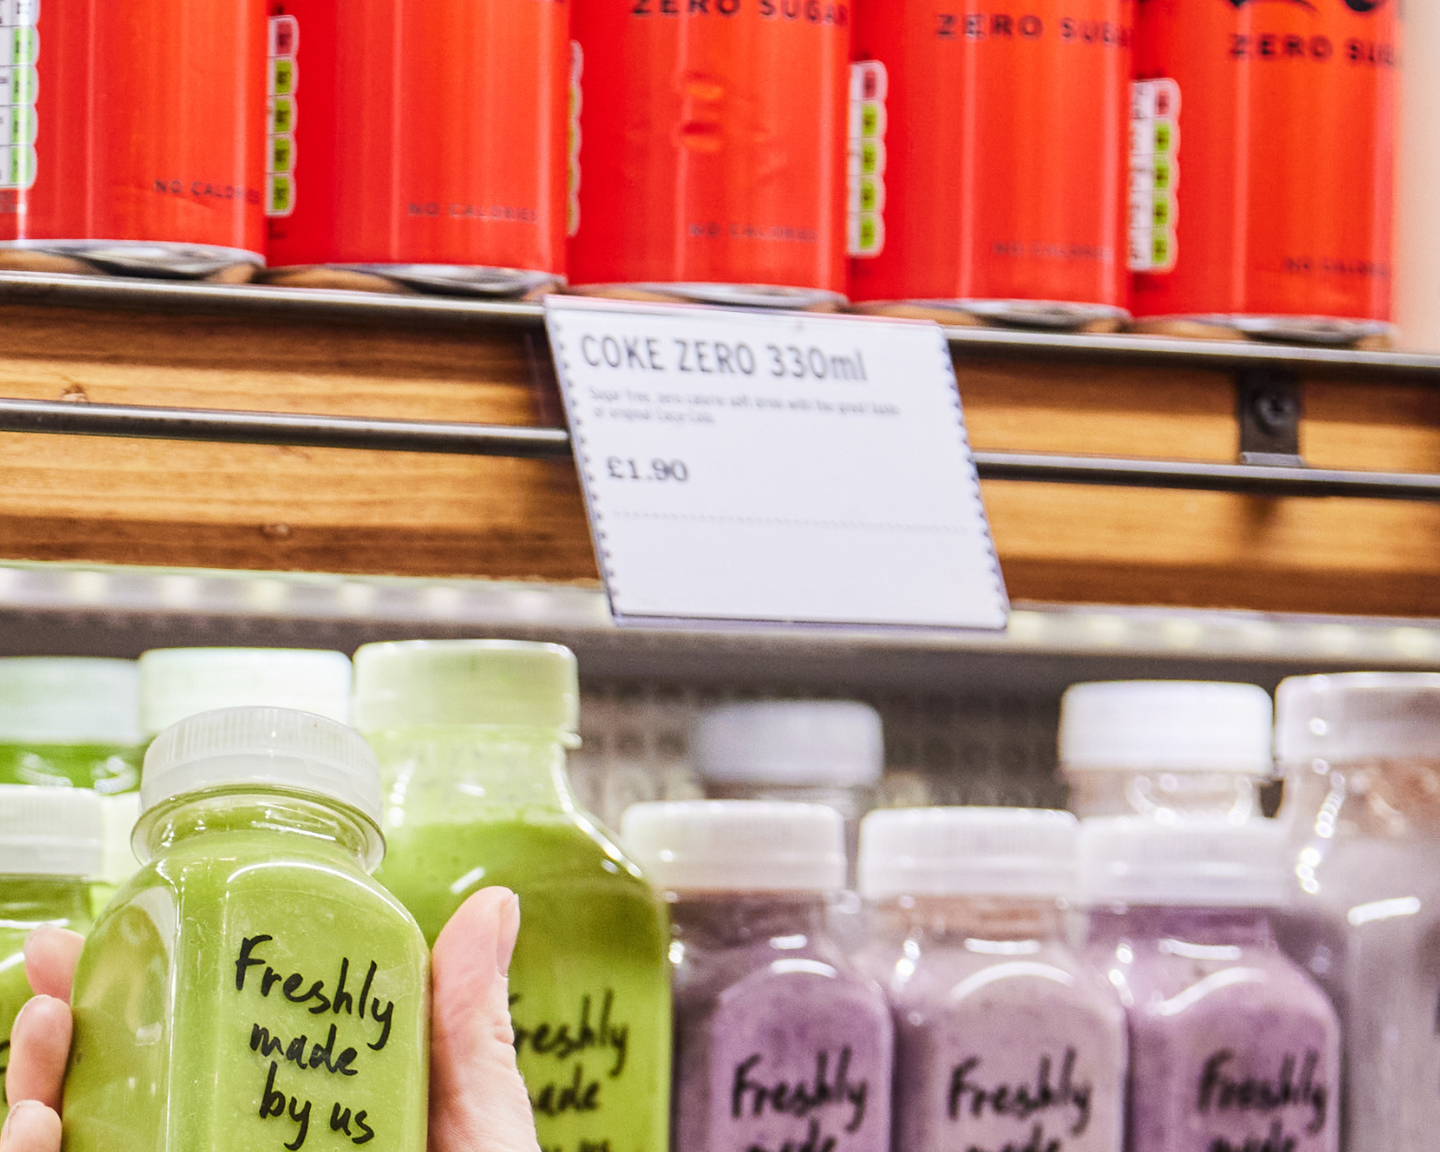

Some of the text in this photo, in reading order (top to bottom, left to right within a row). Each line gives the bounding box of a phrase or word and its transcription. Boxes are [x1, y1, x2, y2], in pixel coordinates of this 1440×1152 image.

[580, 334, 868, 381] COKE ZERO 330ml
[606, 457, 689, 482] £1.90
[235, 934, 396, 1051] Freshly
[249, 1022, 359, 1077] made
[732, 1046, 868, 1133] Freshly
[948, 1047, 1093, 1137] Freshly
[258, 1061, 377, 1151] by us
